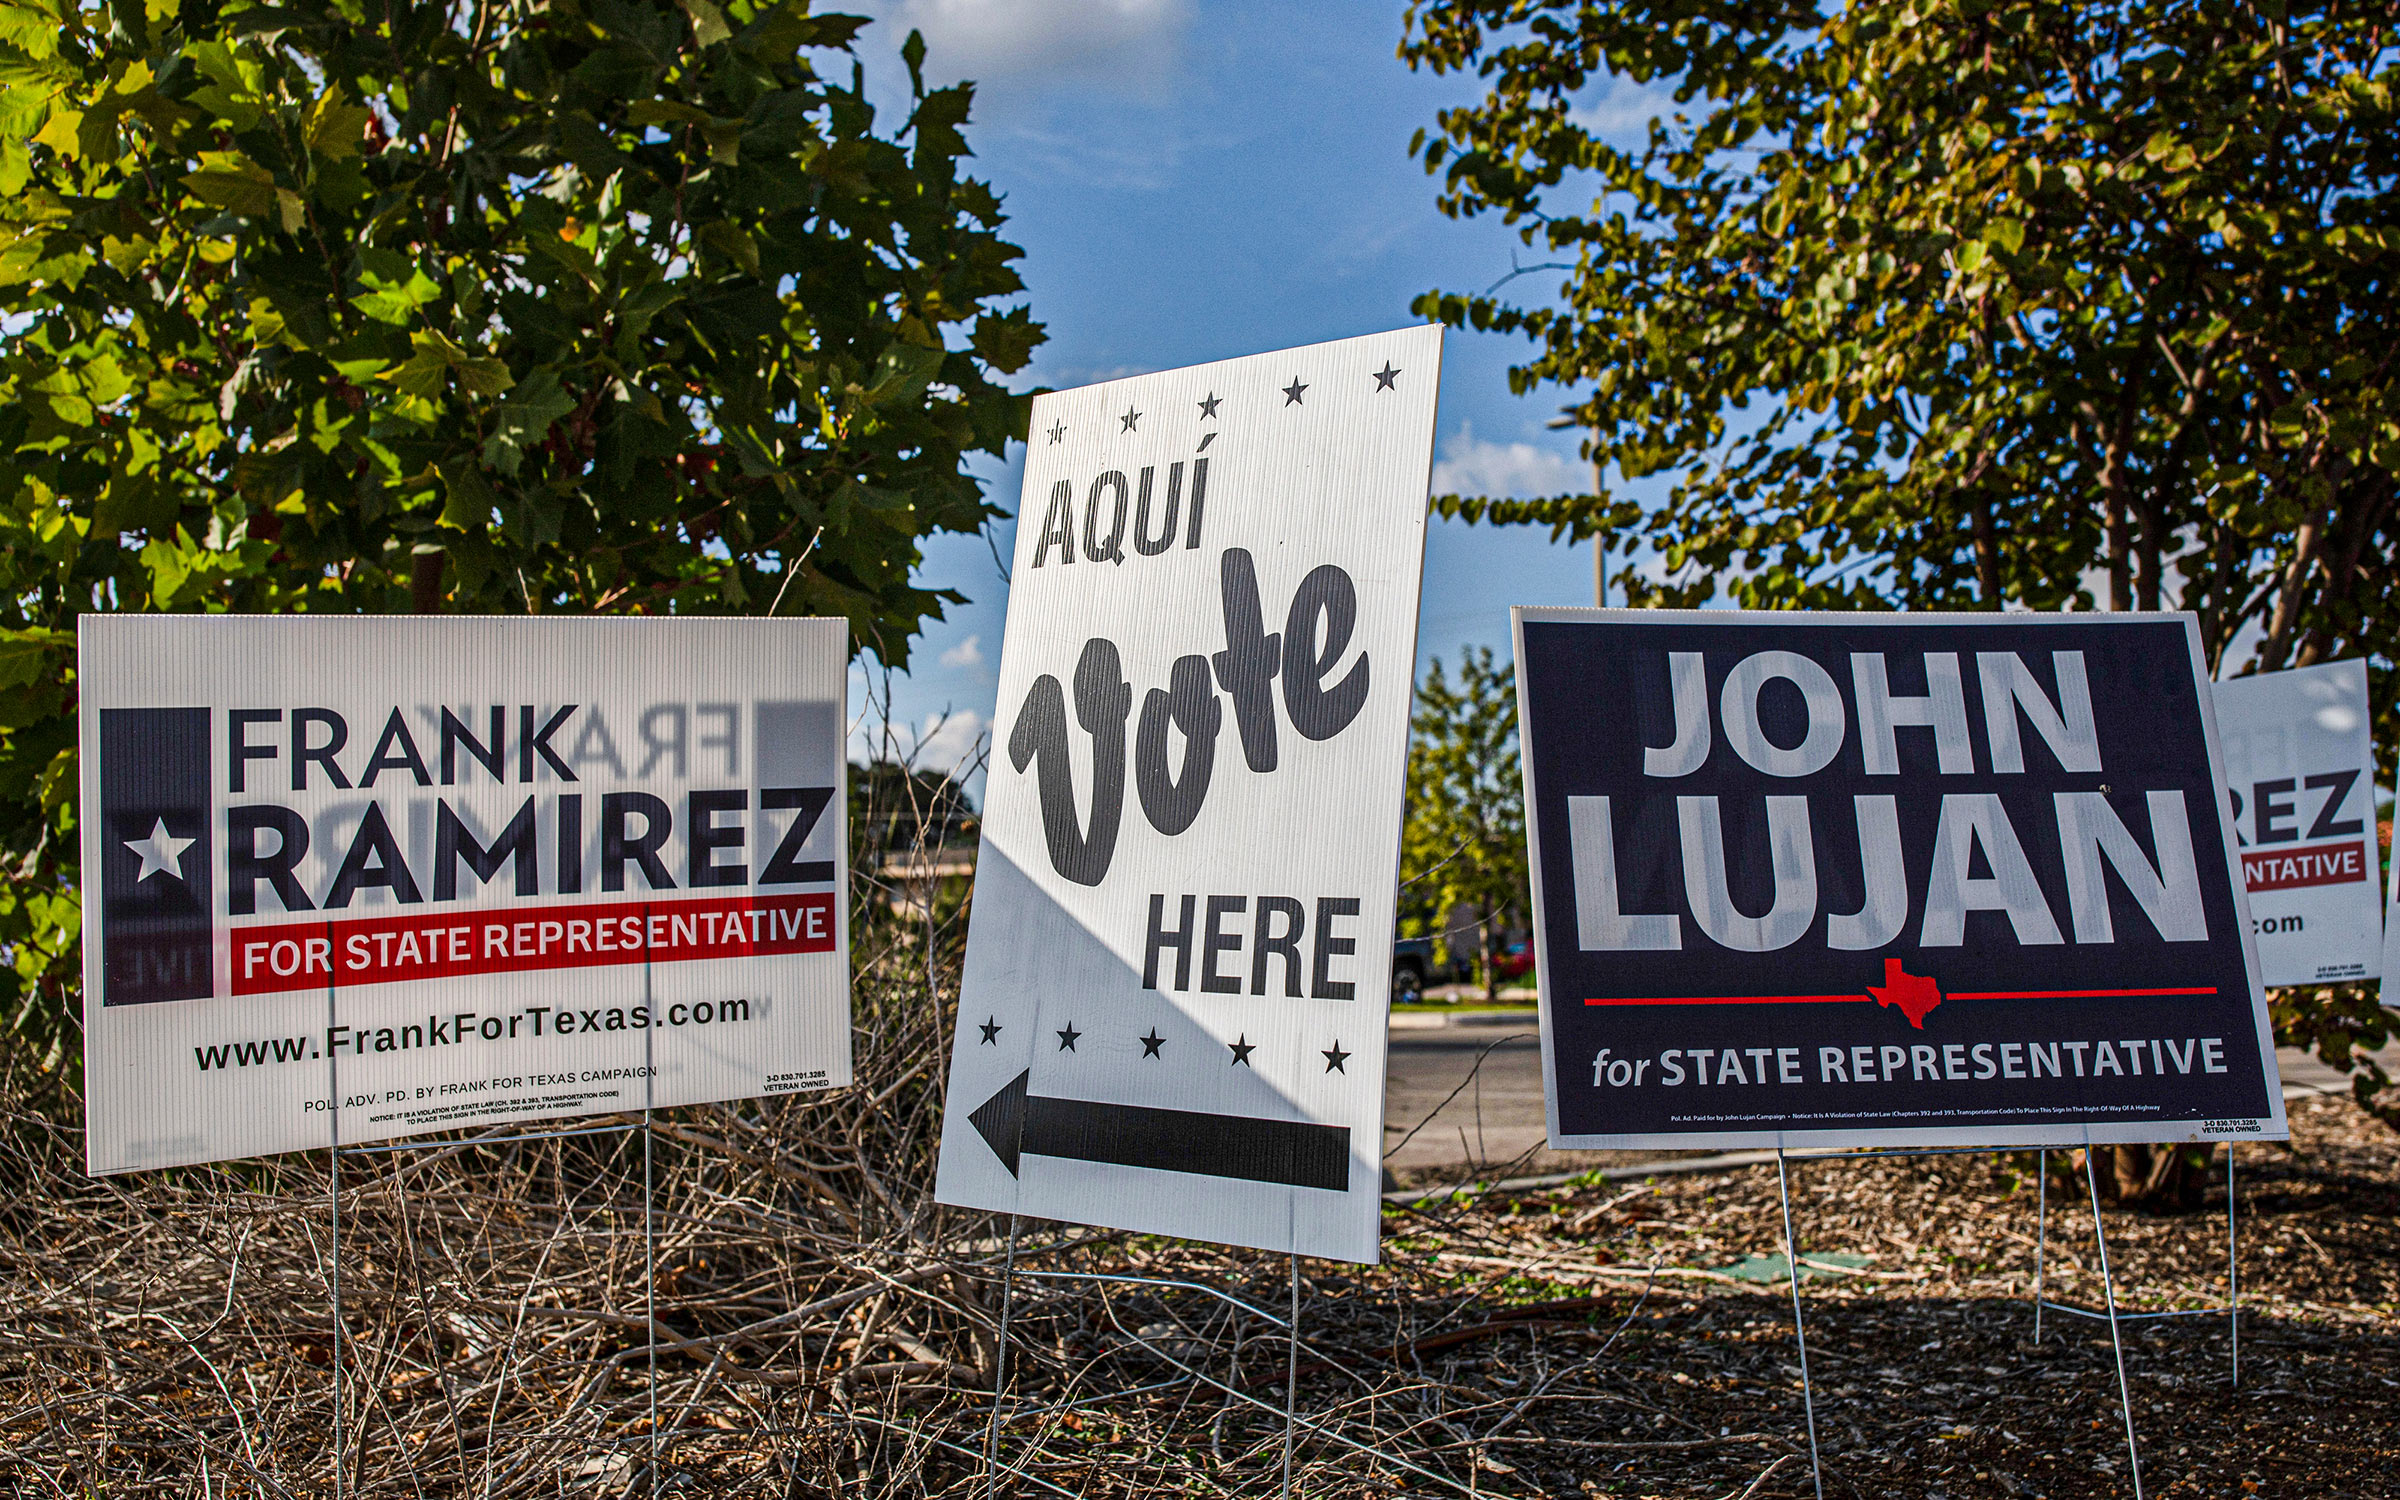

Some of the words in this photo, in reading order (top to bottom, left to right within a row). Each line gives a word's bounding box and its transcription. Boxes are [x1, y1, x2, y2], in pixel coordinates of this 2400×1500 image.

[1032, 432, 1218, 568] AQUÍ
[229, 704, 580, 793] FRANK
[1008, 546, 1370, 887] Vote
[1643, 650, 2102, 778] JOHN
[228, 786, 836, 916] RAMIREZ
[1567, 790, 2209, 952] LUJAN
[244, 937, 333, 979] FOR
[346, 926, 471, 970] STATE
[484, 906, 827, 959] REPRESENTATIVE
[1142, 893, 1360, 1001] HERE
[194, 998, 750, 1071] www.FrankForTexas.com
[1592, 1048, 1650, 1087] for
[1660, 1047, 1803, 1086] STATE
[1819, 1038, 2228, 1083] REPRESENTATIVE
[304, 1099, 339, 1112] POL.
[345, 1093, 380, 1108] ADV.
[386, 1090, 410, 1102] PD.
[416, 1086, 434, 1099] BY
[440, 1080, 488, 1096] FRANK
[492, 1077, 522, 1090] FOR
[528, 1072, 576, 1086] TEXAS
[581, 1066, 657, 1083] CAMPAIGN
[417, 1107, 449, 1116] VIOLATION
[542, 1092, 597, 1102] TRANSPORTATION
[763, 1081, 799, 1092] VETERAN
[801, 1079, 829, 1088] OWNED
[766, 1074, 779, 1082] 3-D
[1739, 1114, 1755, 1122] Lujan
[1756, 1113, 1785, 1121] Campaign
[1956, 1108, 1998, 1116] Transportation
[2052, 1106, 2065, 1114] Sign
[2135, 1104, 2160, 1112] Highway
[417, 1115, 437, 1124] PLACE
